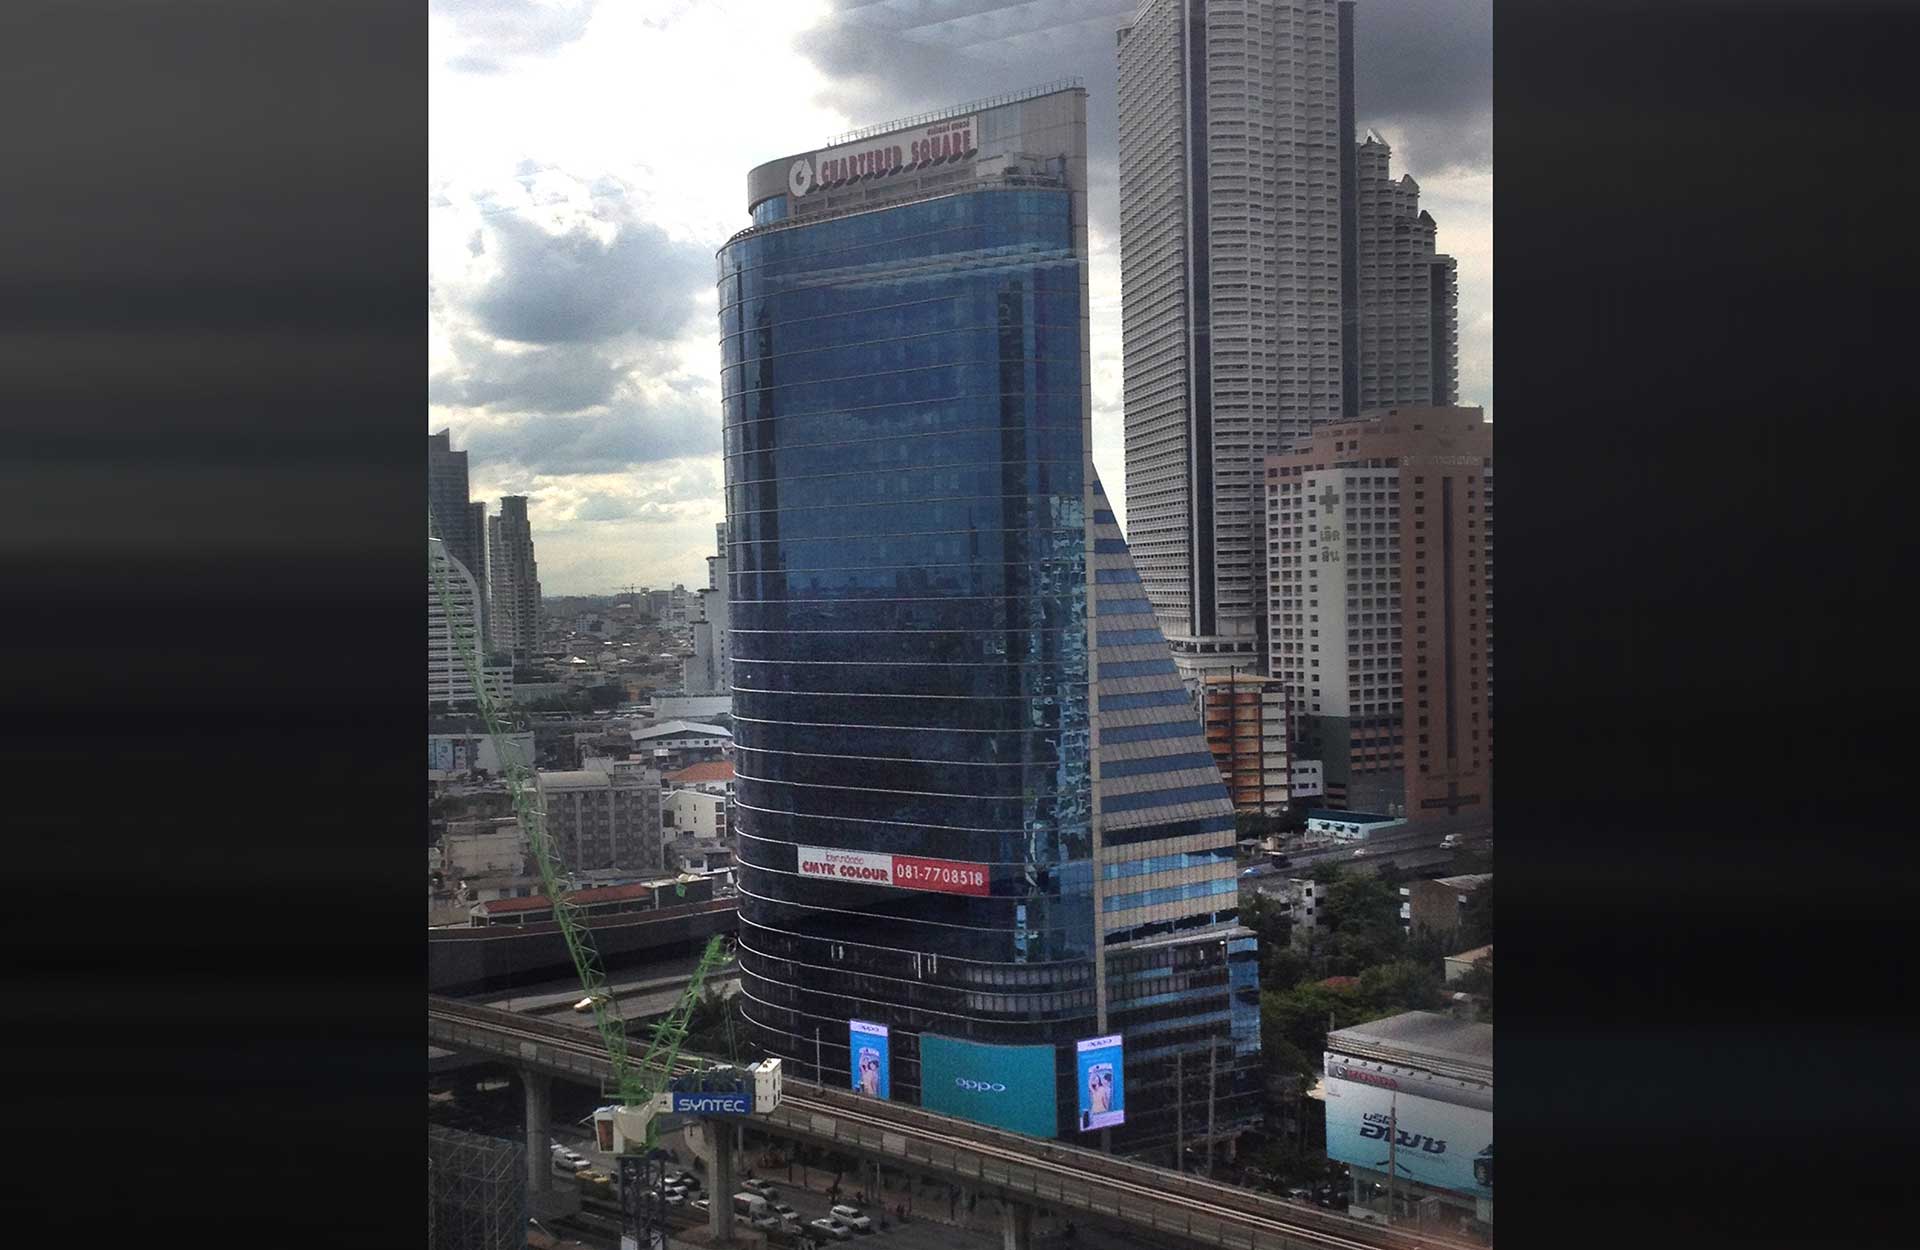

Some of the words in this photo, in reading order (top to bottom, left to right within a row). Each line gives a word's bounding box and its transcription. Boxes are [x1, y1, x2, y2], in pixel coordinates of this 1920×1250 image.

[821, 145, 903, 182] CHARTERED
[911, 129, 971, 165] SQUARE
[802, 860, 836, 876] CMYK
[840, 864, 889, 882] COLOUR
[896, 863, 984, 887] 081-7708518
[678, 1098, 746, 1113] SYNTEC
